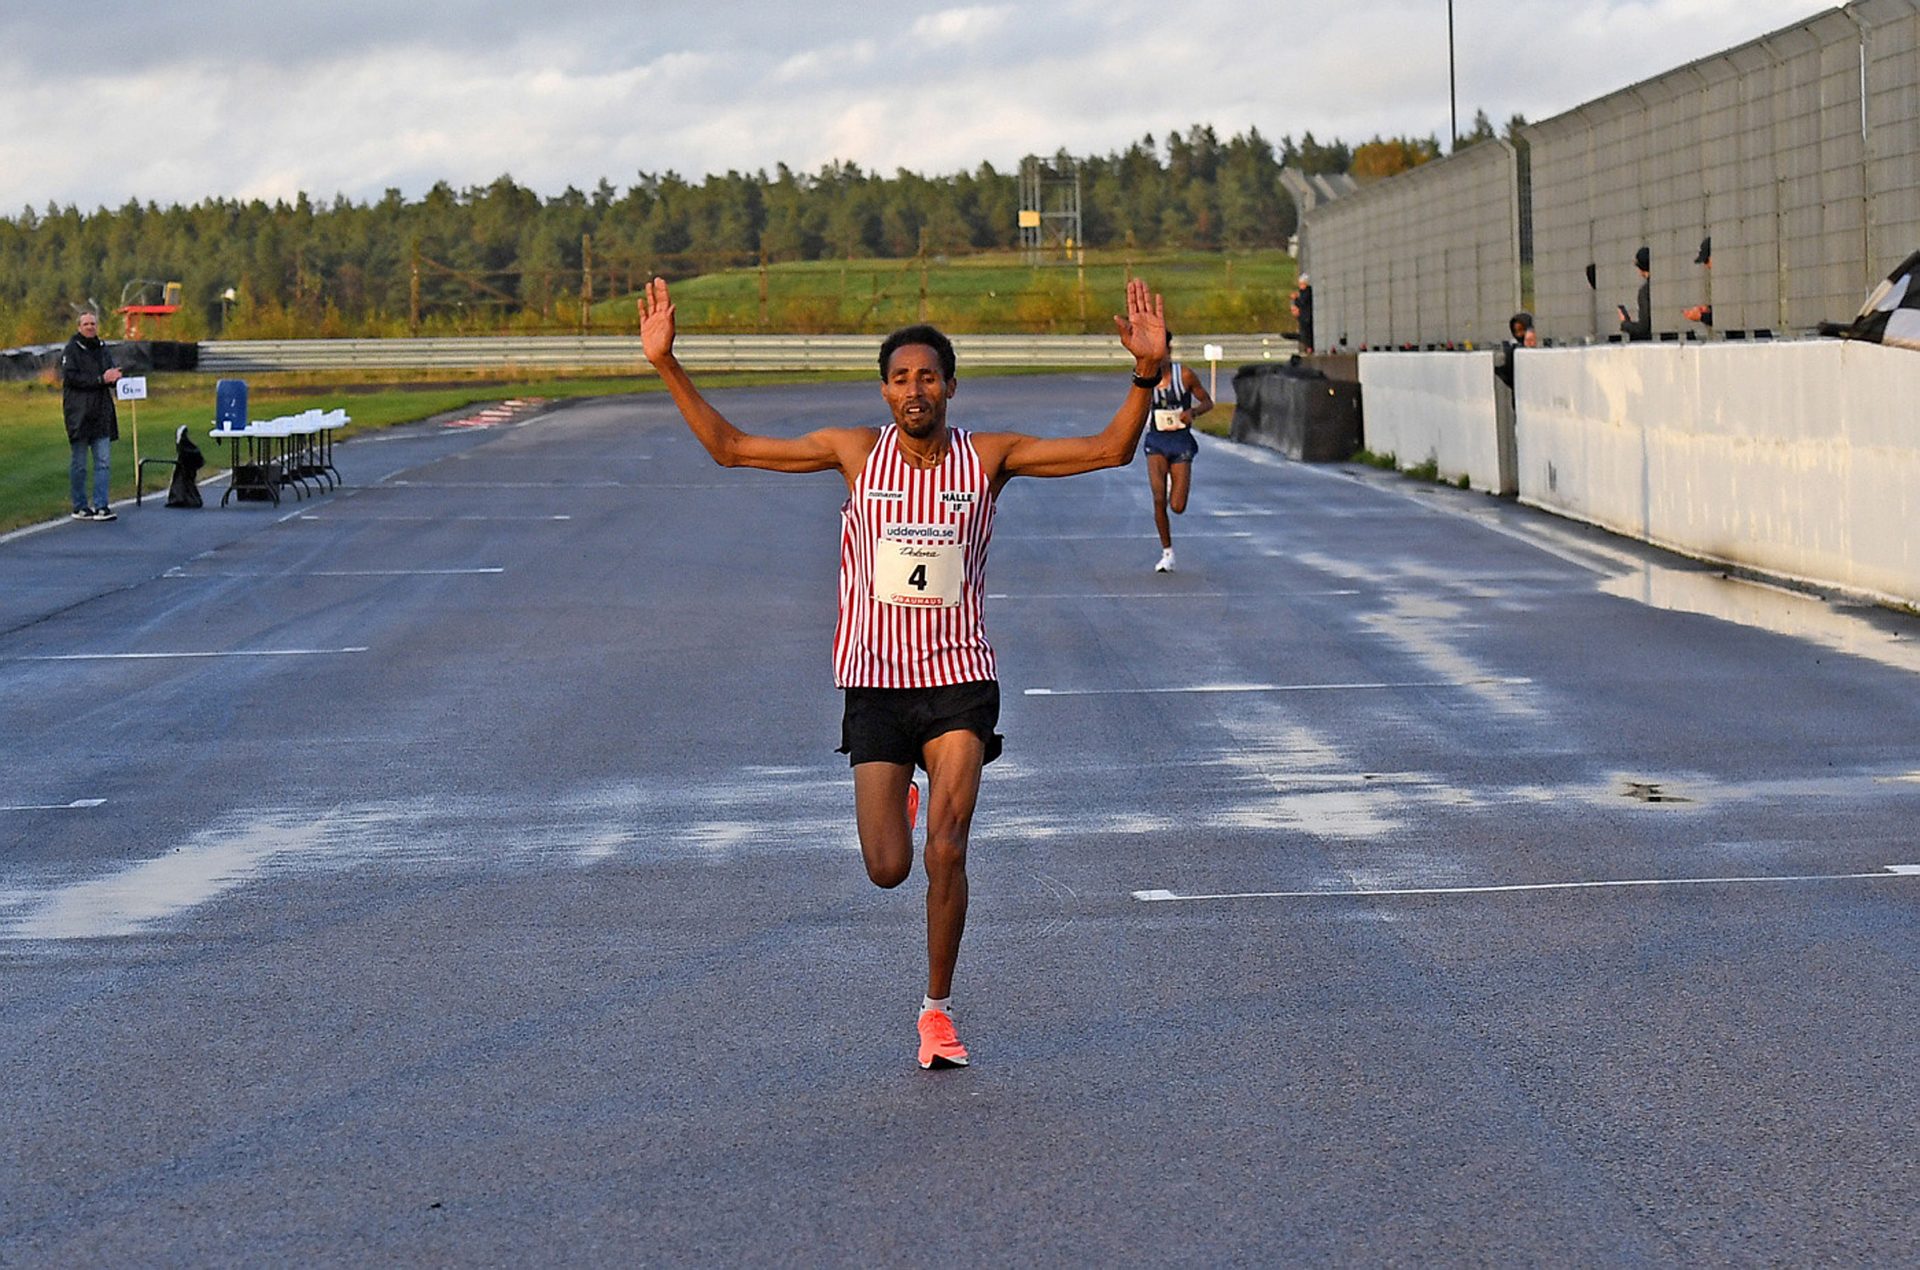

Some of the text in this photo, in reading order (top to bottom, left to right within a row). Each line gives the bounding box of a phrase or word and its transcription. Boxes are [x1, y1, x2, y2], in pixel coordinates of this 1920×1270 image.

[953, 503, 962, 511] IF
[887, 527, 954, 538] uddevalla.se
[908, 564, 927, 591] 4
[898, 596, 942, 605] BAUHAUS
